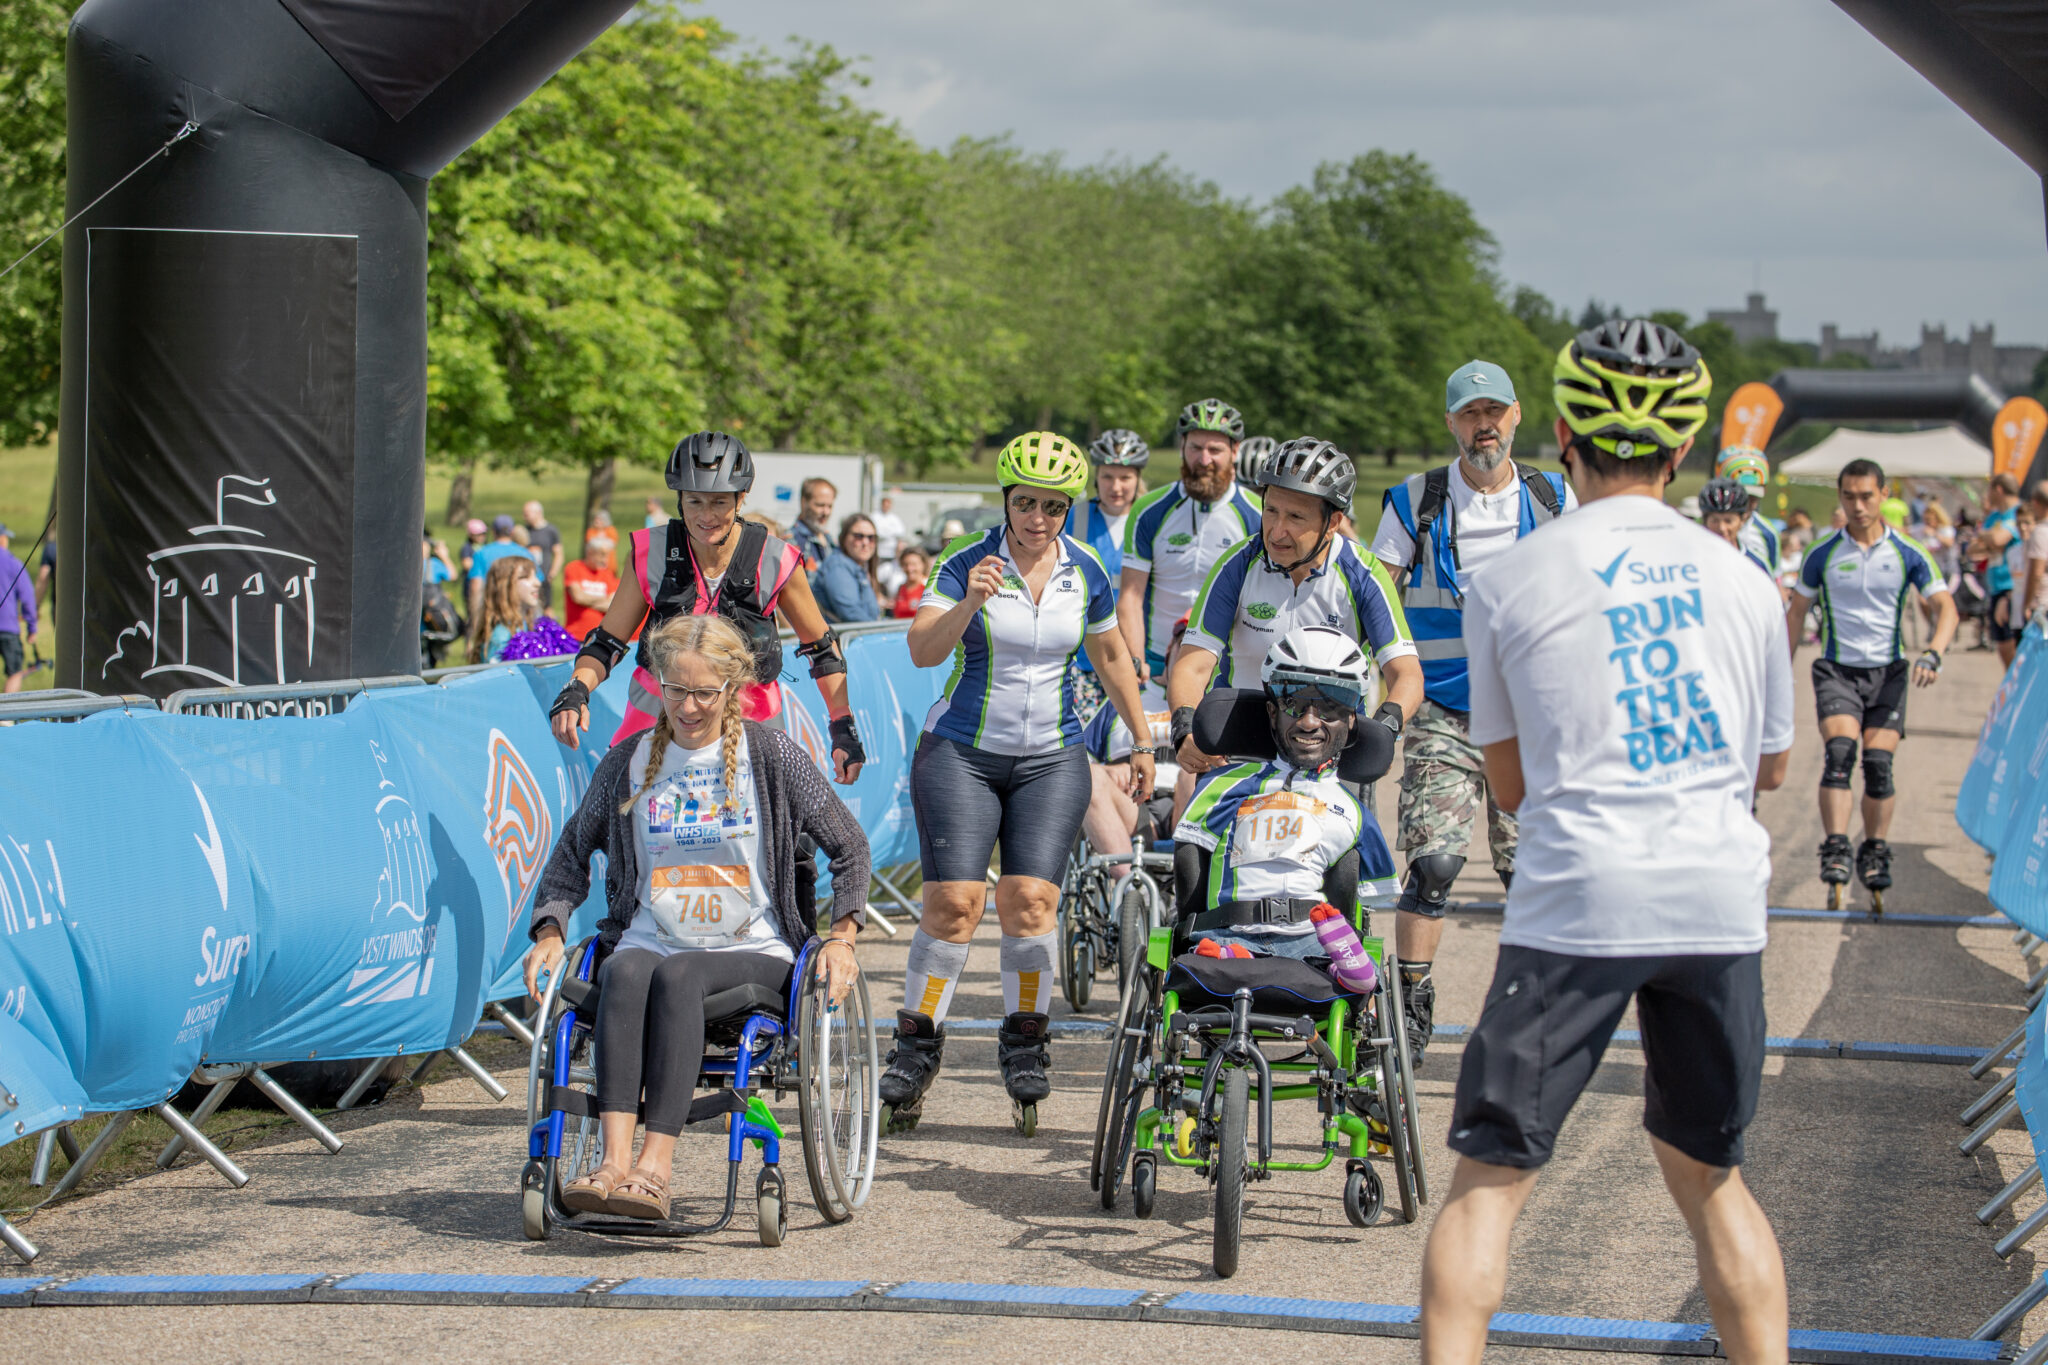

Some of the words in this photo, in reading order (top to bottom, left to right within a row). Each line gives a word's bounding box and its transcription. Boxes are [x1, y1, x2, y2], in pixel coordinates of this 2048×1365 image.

[1627, 561, 1699, 585] Sure
[997, 592, 1019, 600] Becky
[1601, 587, 1706, 646] RUN
[1608, 638, 1680, 686] TO
[1615, 670, 1712, 729] THE
[675, 827, 702, 839] NHS
[704, 824, 719, 836] 75
[676, 839, 695, 847] 1948
[702, 836, 721, 844] 2023
[1249, 815, 1305, 842] 1134
[676, 893, 723, 924] 746
[387, 924, 437, 961] WINDSOR
[1335, 939, 1361, 969] BAM
